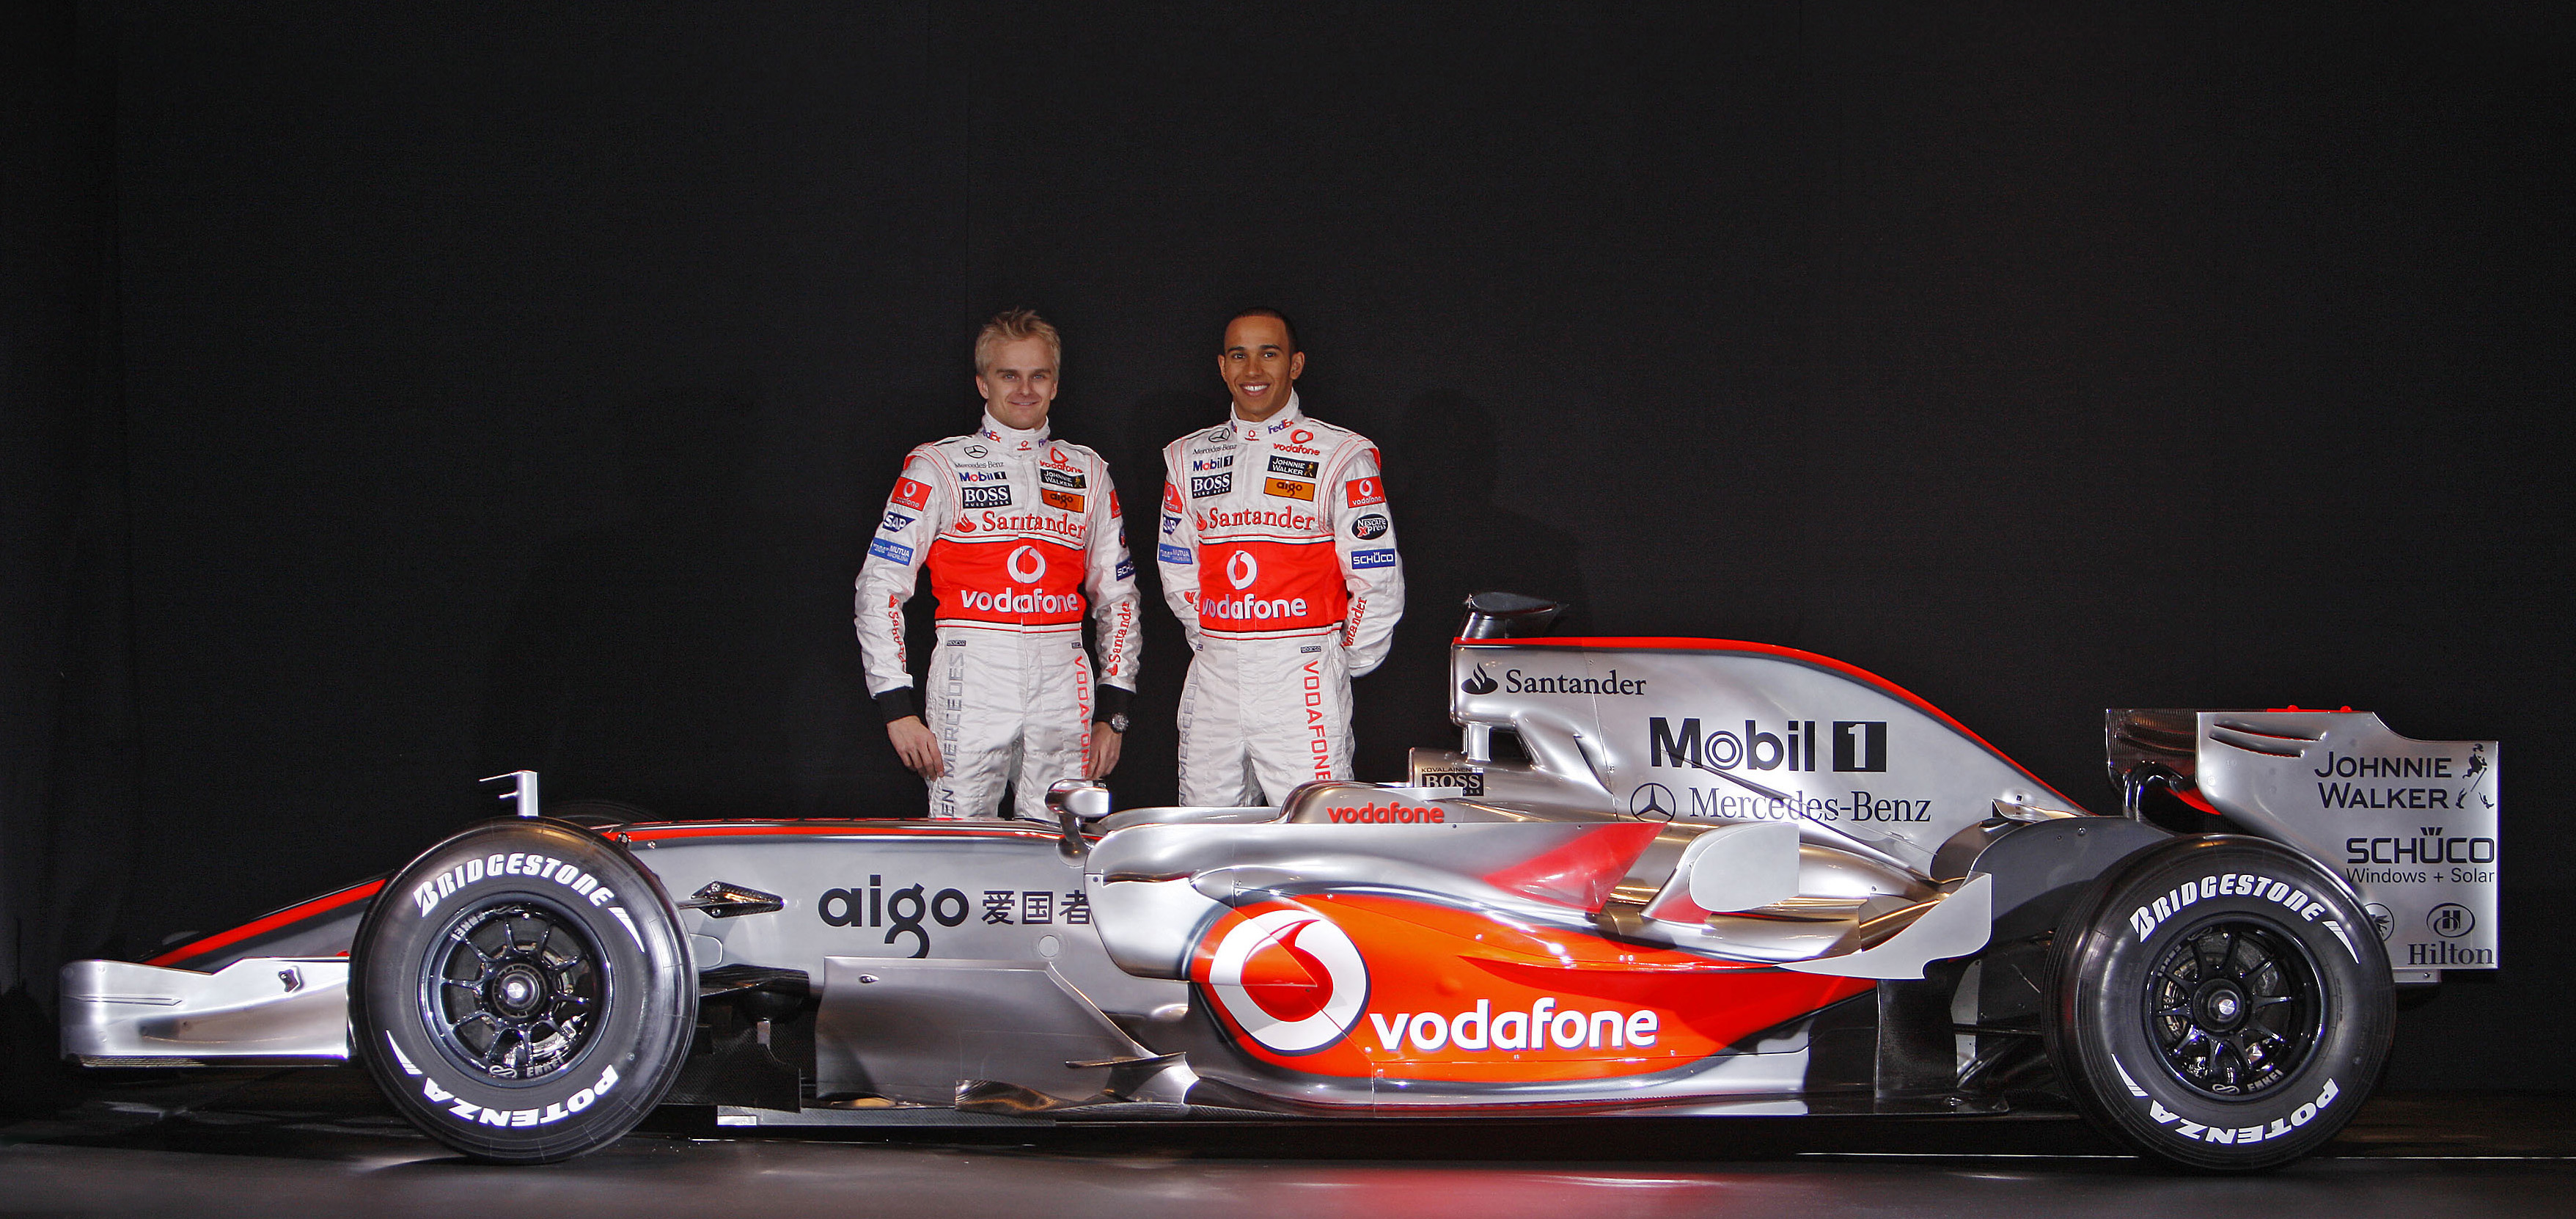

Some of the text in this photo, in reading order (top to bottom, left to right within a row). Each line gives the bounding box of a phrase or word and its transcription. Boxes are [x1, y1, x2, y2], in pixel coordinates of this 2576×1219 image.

[1268, 419, 1294, 434] FedEx
[1274, 443, 1320, 455] vodafone
[1039, 460, 1083, 473] vodafone
[1193, 458, 1222, 471] Mobil
[1272, 458, 1305, 469] JOHNNIE
[1272, 465, 1304, 475] WALKER
[959, 472, 994, 481] Mobil
[1044, 471, 1072, 482] JOHNNIE
[1193, 474, 1230, 491] BOSS
[1277, 481, 1302, 497] aigo
[964, 487, 1009, 502] BOSS
[1050, 492, 1074, 508] aigo
[1352, 496, 1382, 505] vodafone
[884, 515, 906, 530] SAP
[983, 510, 1085, 539] Santander
[1209, 505, 1315, 530] Santander
[889, 545, 909, 557] MUTUA
[1353, 552, 1393, 565] SCHÜCO
[961, 587, 1079, 614] vodafone
[1203, 593, 1307, 619] vodafone
[1109, 601, 1131, 663] Santander
[1506, 669, 1646, 695] Santander
[944, 652, 964, 777] MERCEDES
[1074, 655, 1090, 777] VODAFONE
[1303, 660, 1332, 780] VODAFONE
[1649, 717, 1816, 772] Mobil
[2314, 751, 2452, 778] JOHNNIE
[1425, 775, 1480, 788] BOSS
[1689, 787, 1931, 822] Mercedes-Benz
[2317, 782, 2449, 809] WALKER
[1326, 801, 1445, 824] vodafone
[2346, 827, 2494, 863] SCHÜCO
[413, 853, 615, 917] BRIDGESTONE
[2346, 868, 2426, 883] Windows
[2451, 868, 2495, 883] Solar
[818, 874, 969, 958] aigo
[981, 890, 1091, 925] 爱国者
[2129, 874, 2326, 943] BRIDGESTONE
[2407, 941, 2494, 965] Hilton
[1370, 997, 1658, 1050] vodafone
[423, 1064, 619, 1127] POTENZA
[2148, 1077, 2341, 1144] POTENZA
